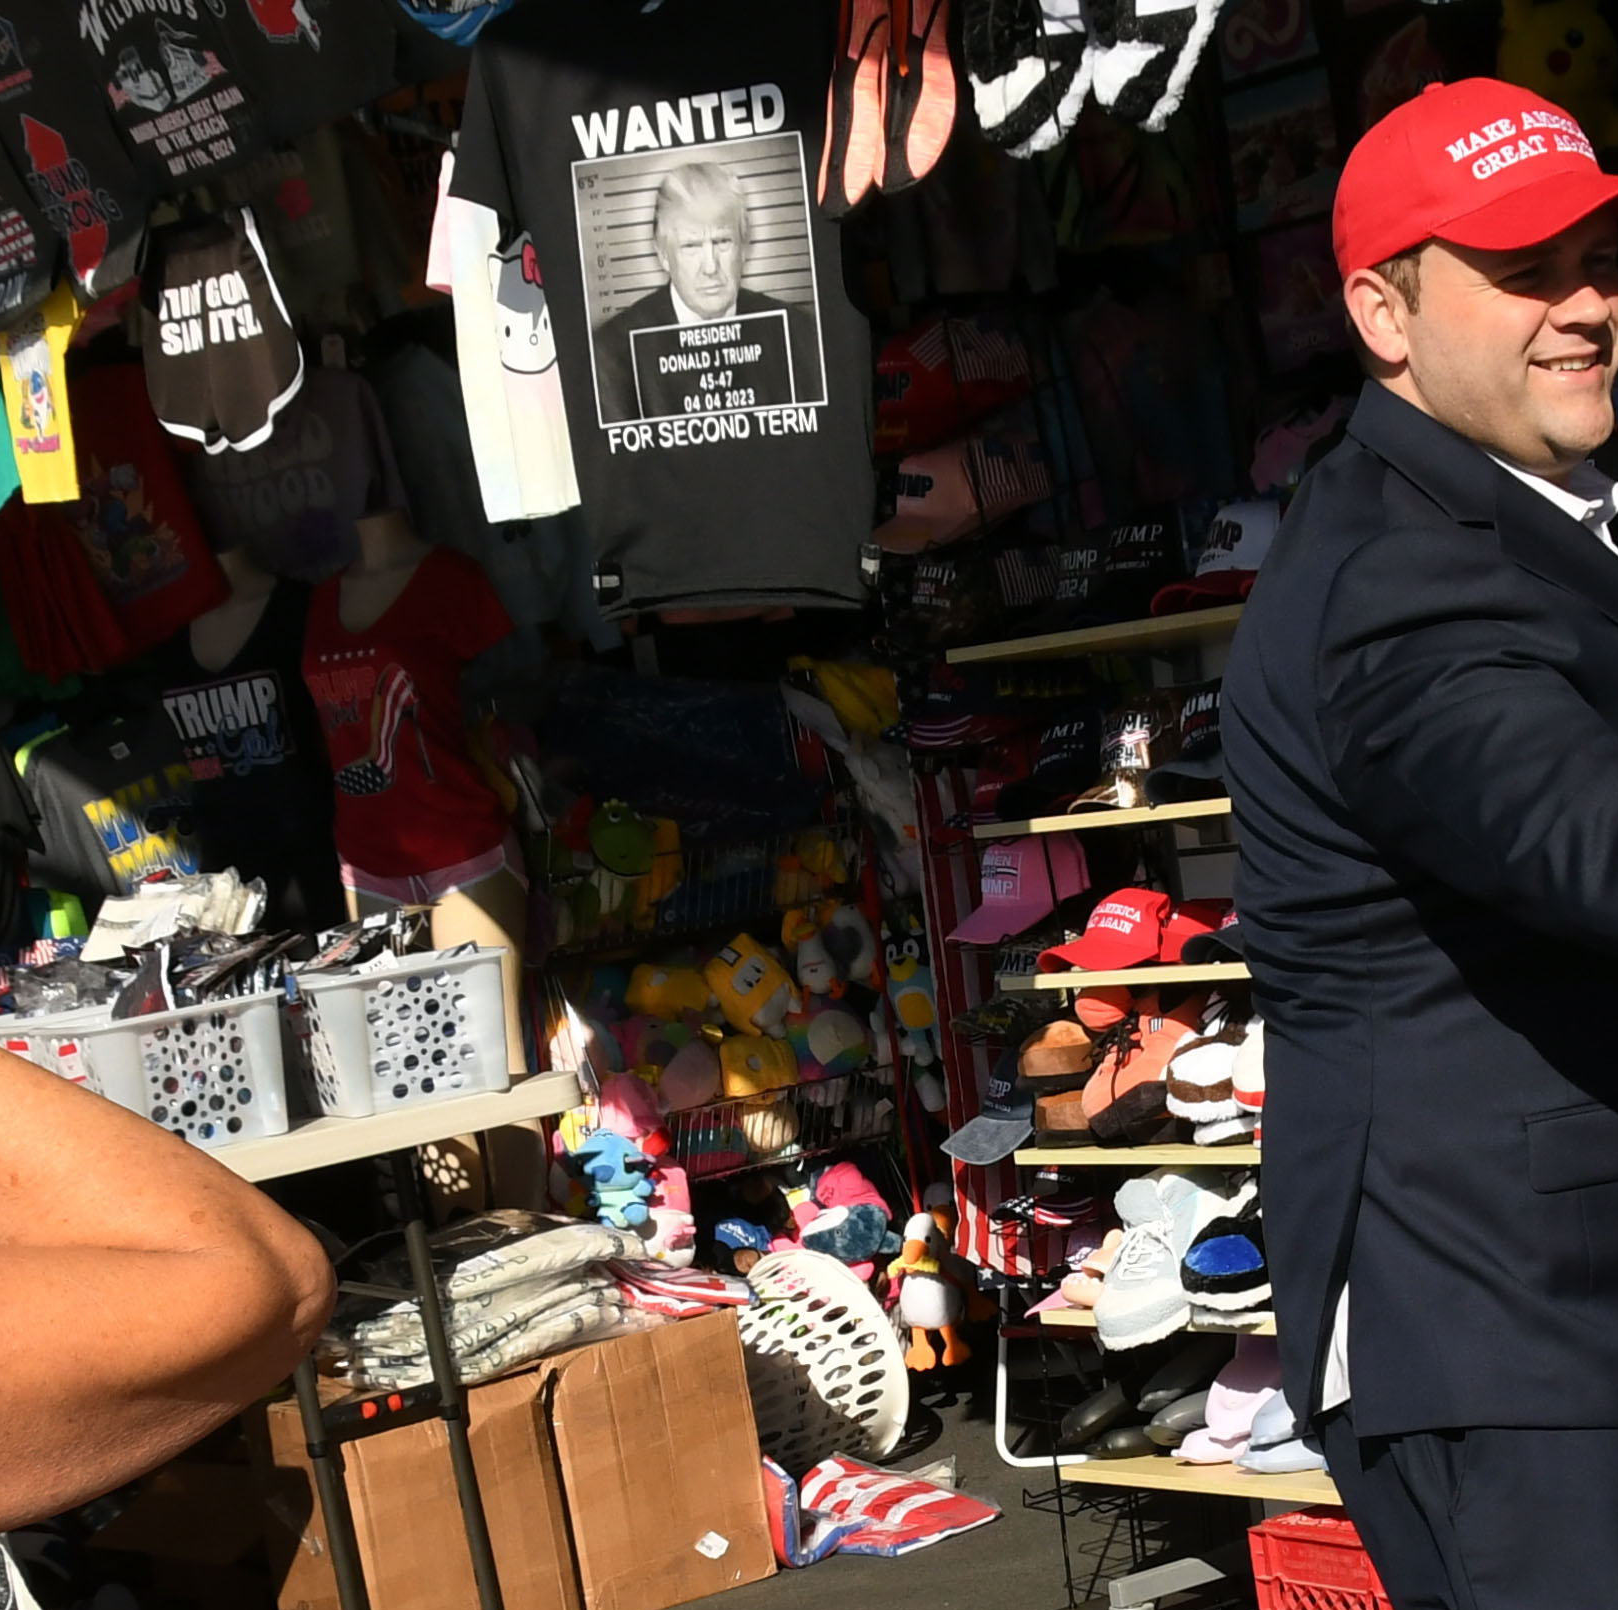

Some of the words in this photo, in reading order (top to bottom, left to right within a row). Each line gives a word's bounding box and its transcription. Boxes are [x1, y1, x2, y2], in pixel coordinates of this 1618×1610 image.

[571, 81, 787, 159] WANTED
[1445, 117, 1517, 163] MAKE
[1471, 134, 1548, 180] GREAT
[679, 323, 742, 347] PRESIDENT
[658, 350, 710, 374] DONALD
[713, 349, 721, 367] J
[722, 344, 762, 364] TRUMP
[698, 370, 734, 391] 45-47
[683, 394, 702, 414] 04
[704, 392, 723, 410] 04
[725, 386, 756, 409] 2023
[607, 425, 655, 455] FOR
[658, 412, 751, 449] SECOND
[753, 407, 818, 436] TERM
[1059, 548, 1099, 570] TRUMP
[1056, 580, 1090, 601] 2024
[162, 677, 279, 740] TRUMP
[216, 707, 285, 777] Girl
[981, 853, 1013, 867] MEN
[981, 879, 1014, 895] UMP
